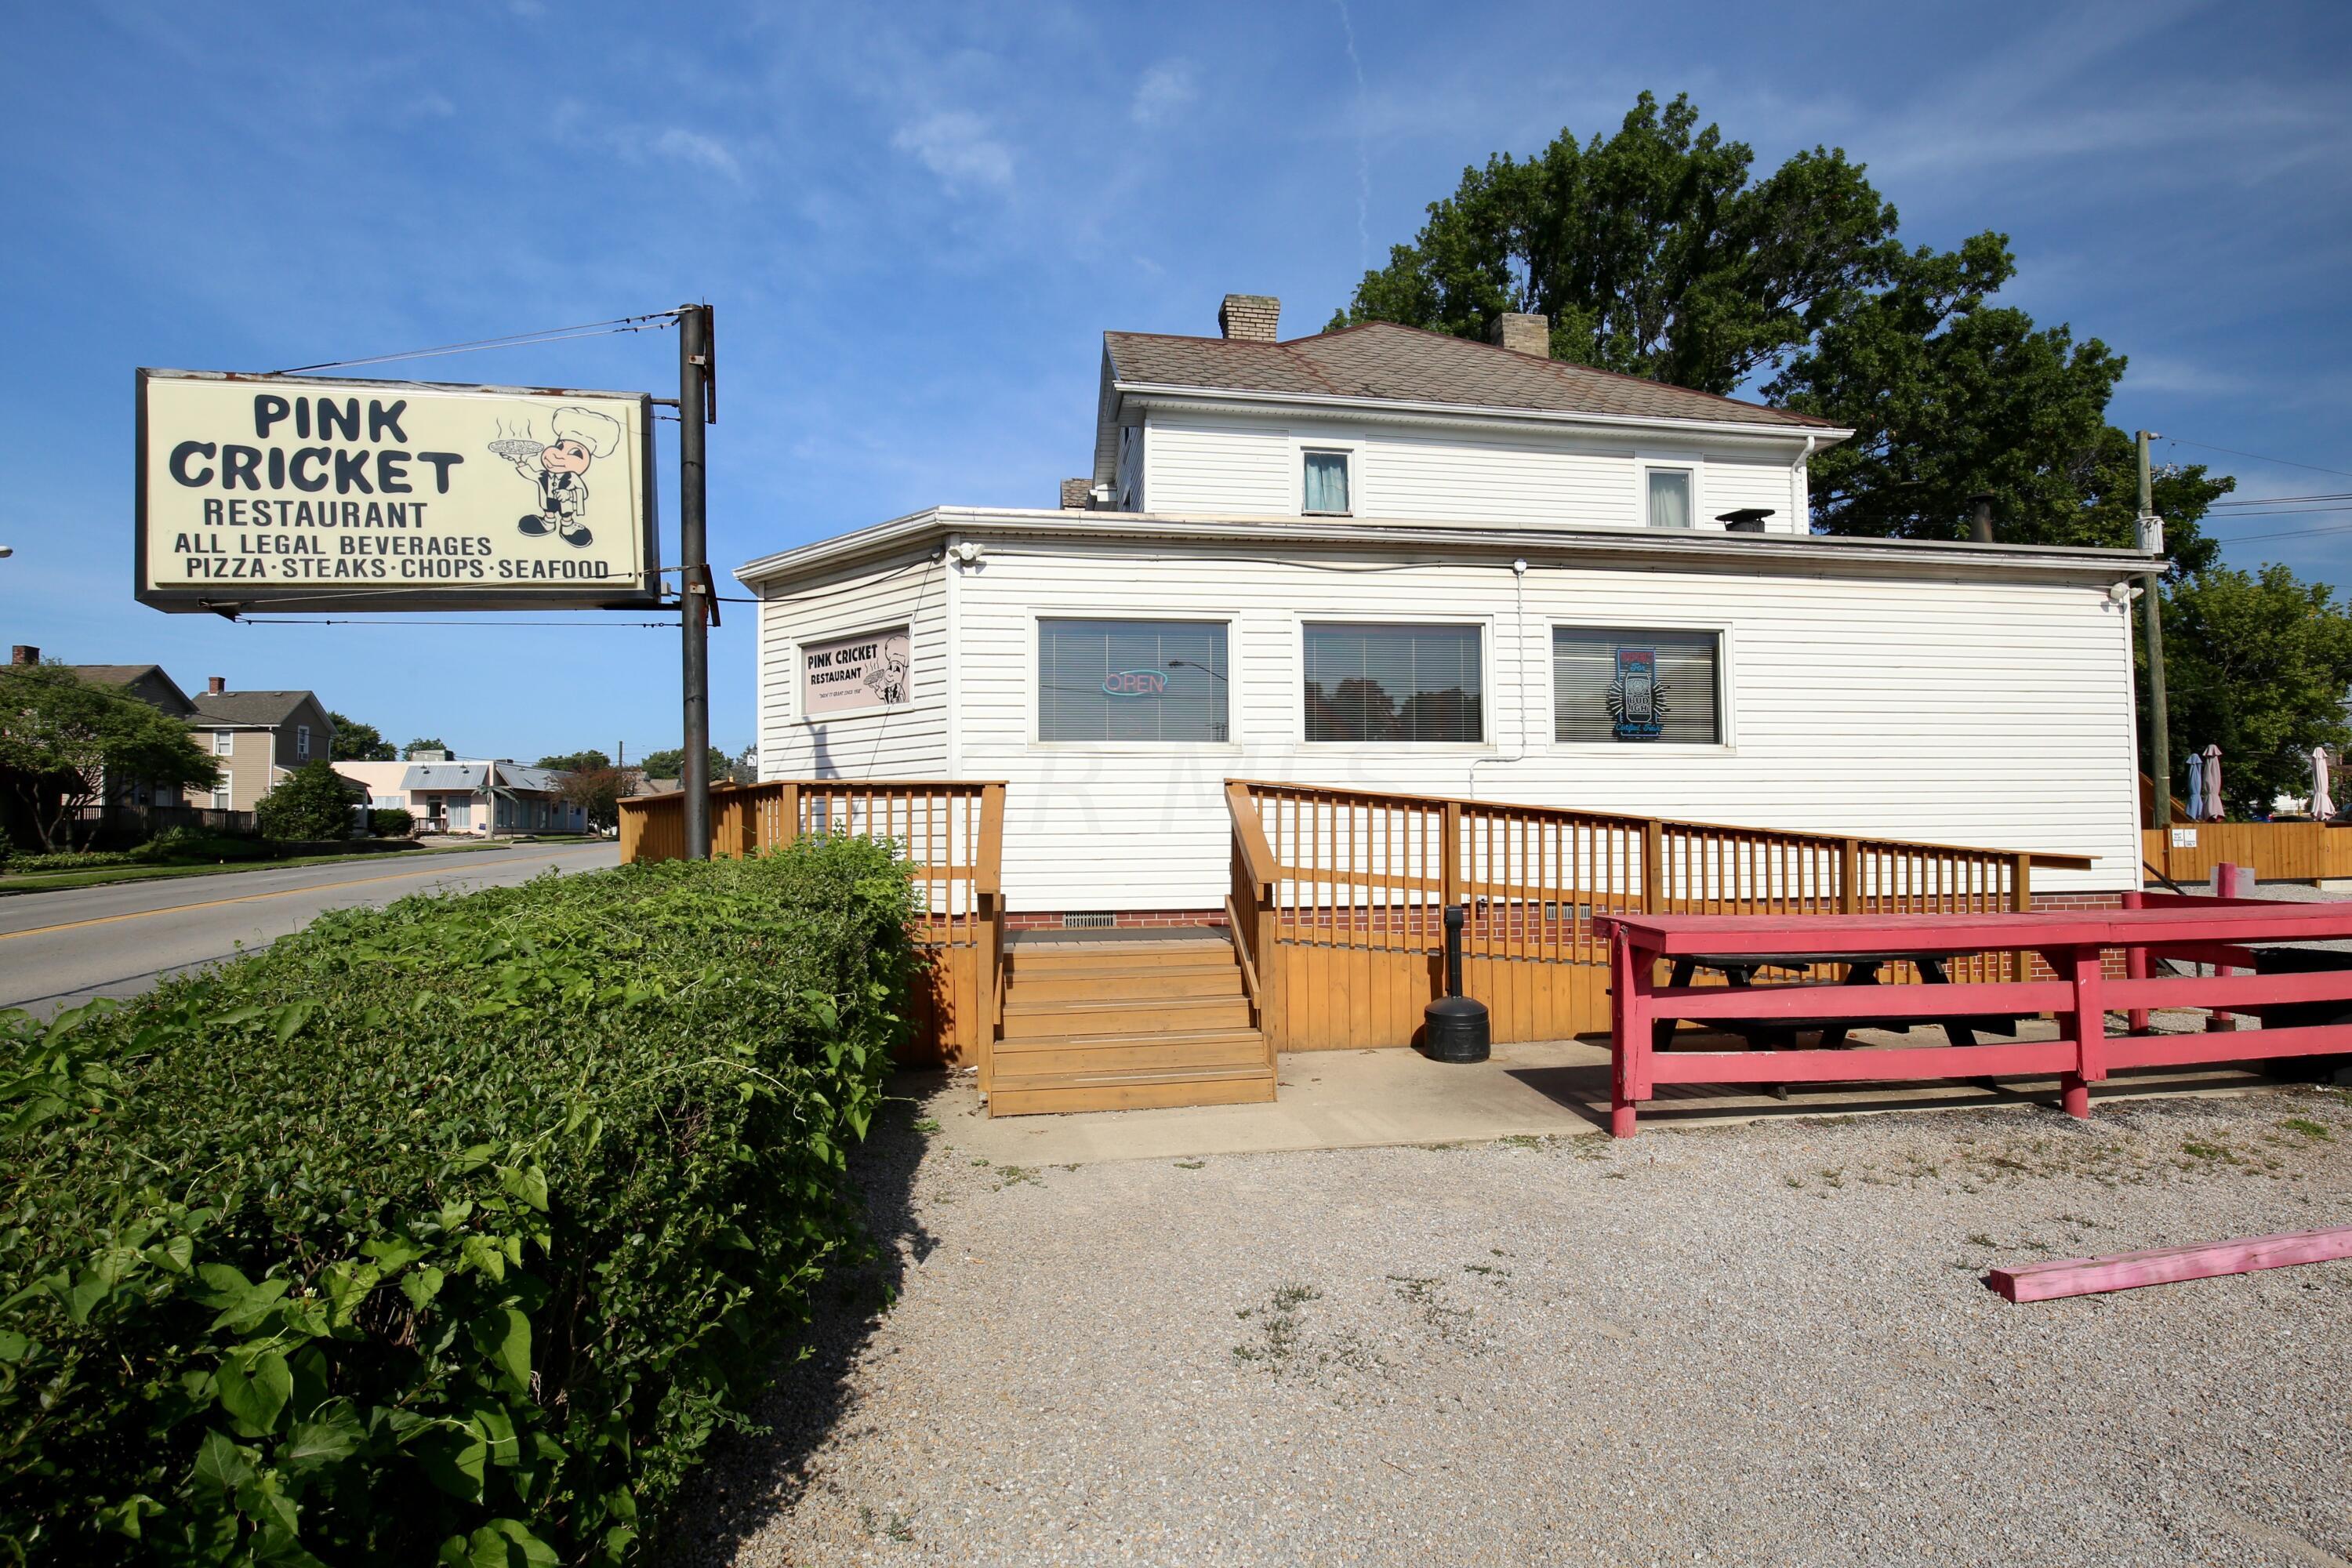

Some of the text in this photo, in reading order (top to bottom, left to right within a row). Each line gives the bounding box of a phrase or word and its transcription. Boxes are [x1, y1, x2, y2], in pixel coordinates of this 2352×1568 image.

[254, 394, 408, 443] PINK
[169, 441, 464, 494] CRICKET
[204, 499, 427, 528] RESTAURANT
[175, 533, 492, 556] ALL LEGAL BEVERAGES
[187, 557, 608, 579] PIZZA STEAKS CHOPS SEAFOOD
[808, 644, 878, 670] PINK CRICKET
[811, 667, 862, 685] RESTAURANT
[1105, 673, 1163, 692] OPEN
[1628, 696, 1650, 705] BUD
